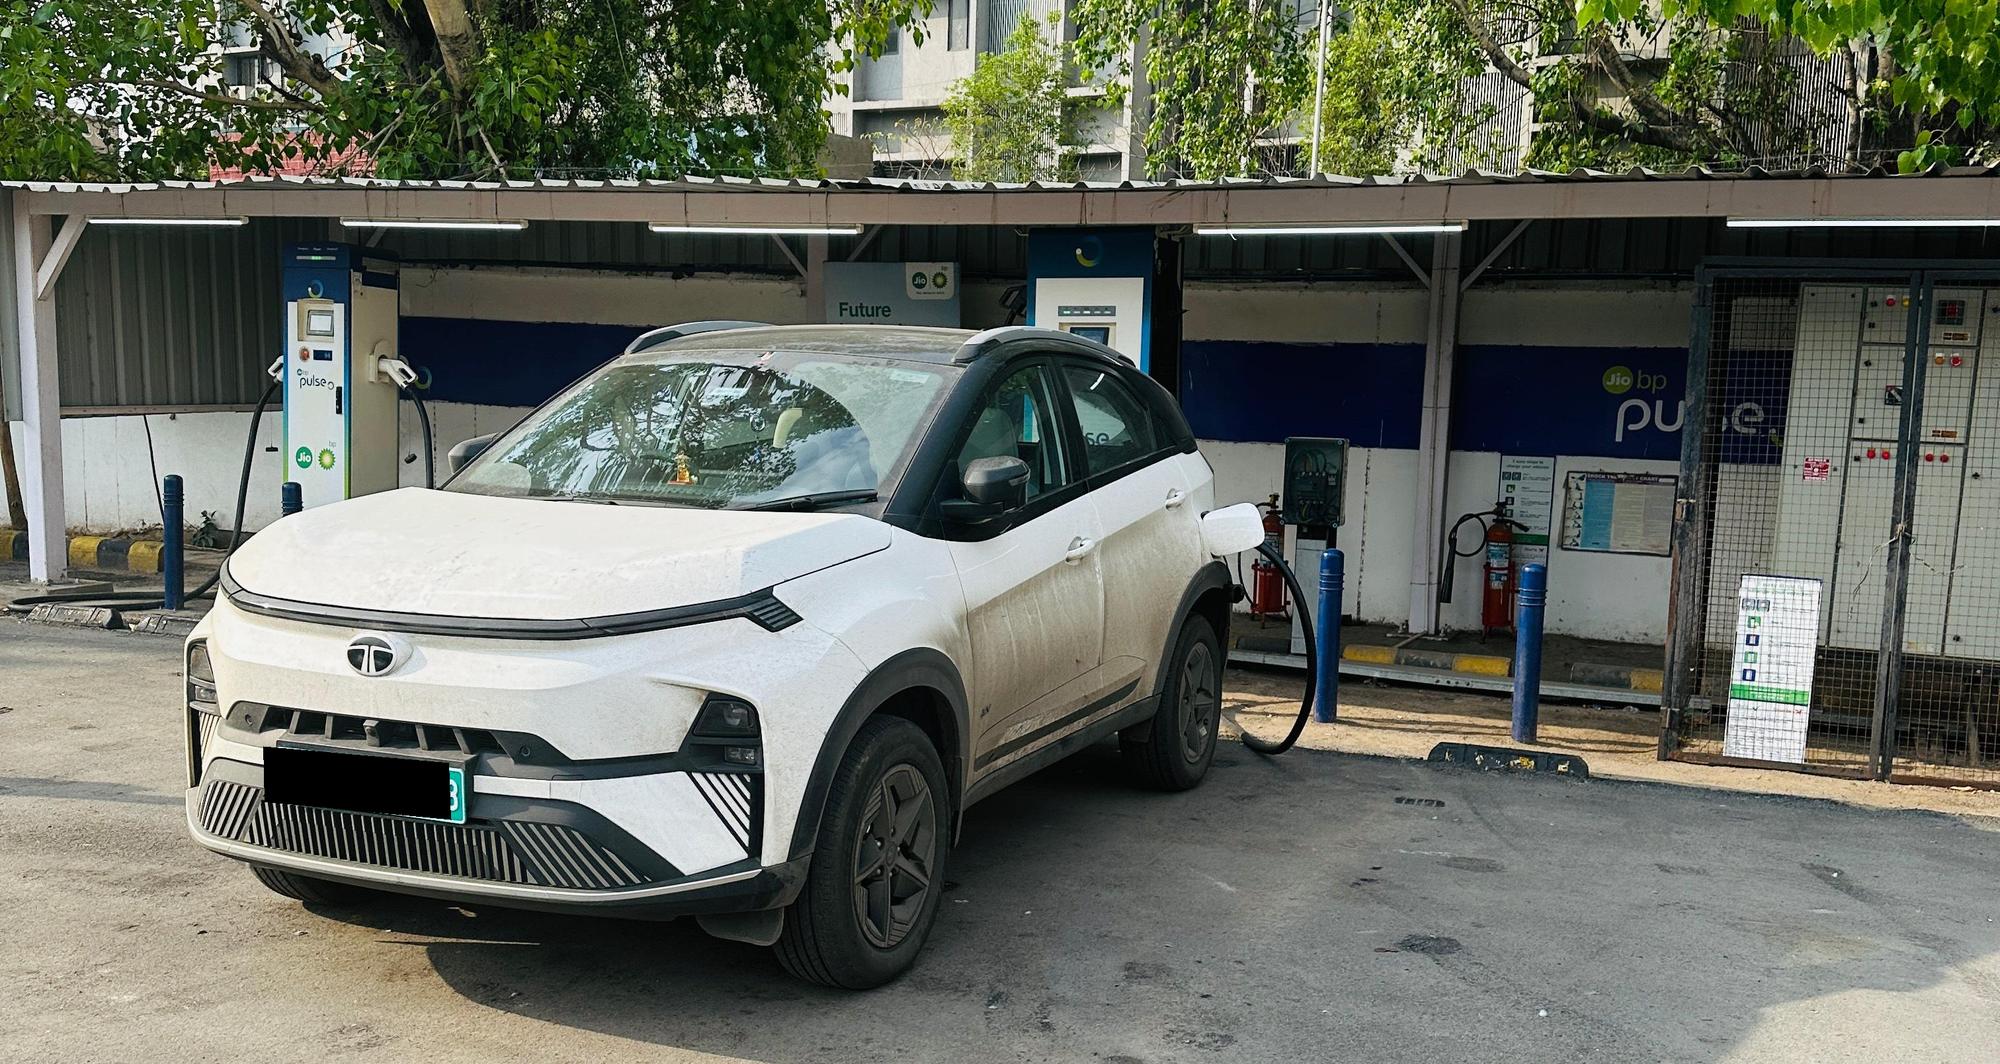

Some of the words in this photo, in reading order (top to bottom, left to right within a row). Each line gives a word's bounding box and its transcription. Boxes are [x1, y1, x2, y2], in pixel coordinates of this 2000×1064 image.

[913, 276, 927, 285] Jio
[839, 302, 891, 317] Future
[299, 374, 327, 389] pulse
[1606, 373, 1631, 386] Jio
[1637, 370, 1667, 394] bp
[1615, 399, 1765, 442] pue
[297, 451, 312, 463] Jio
